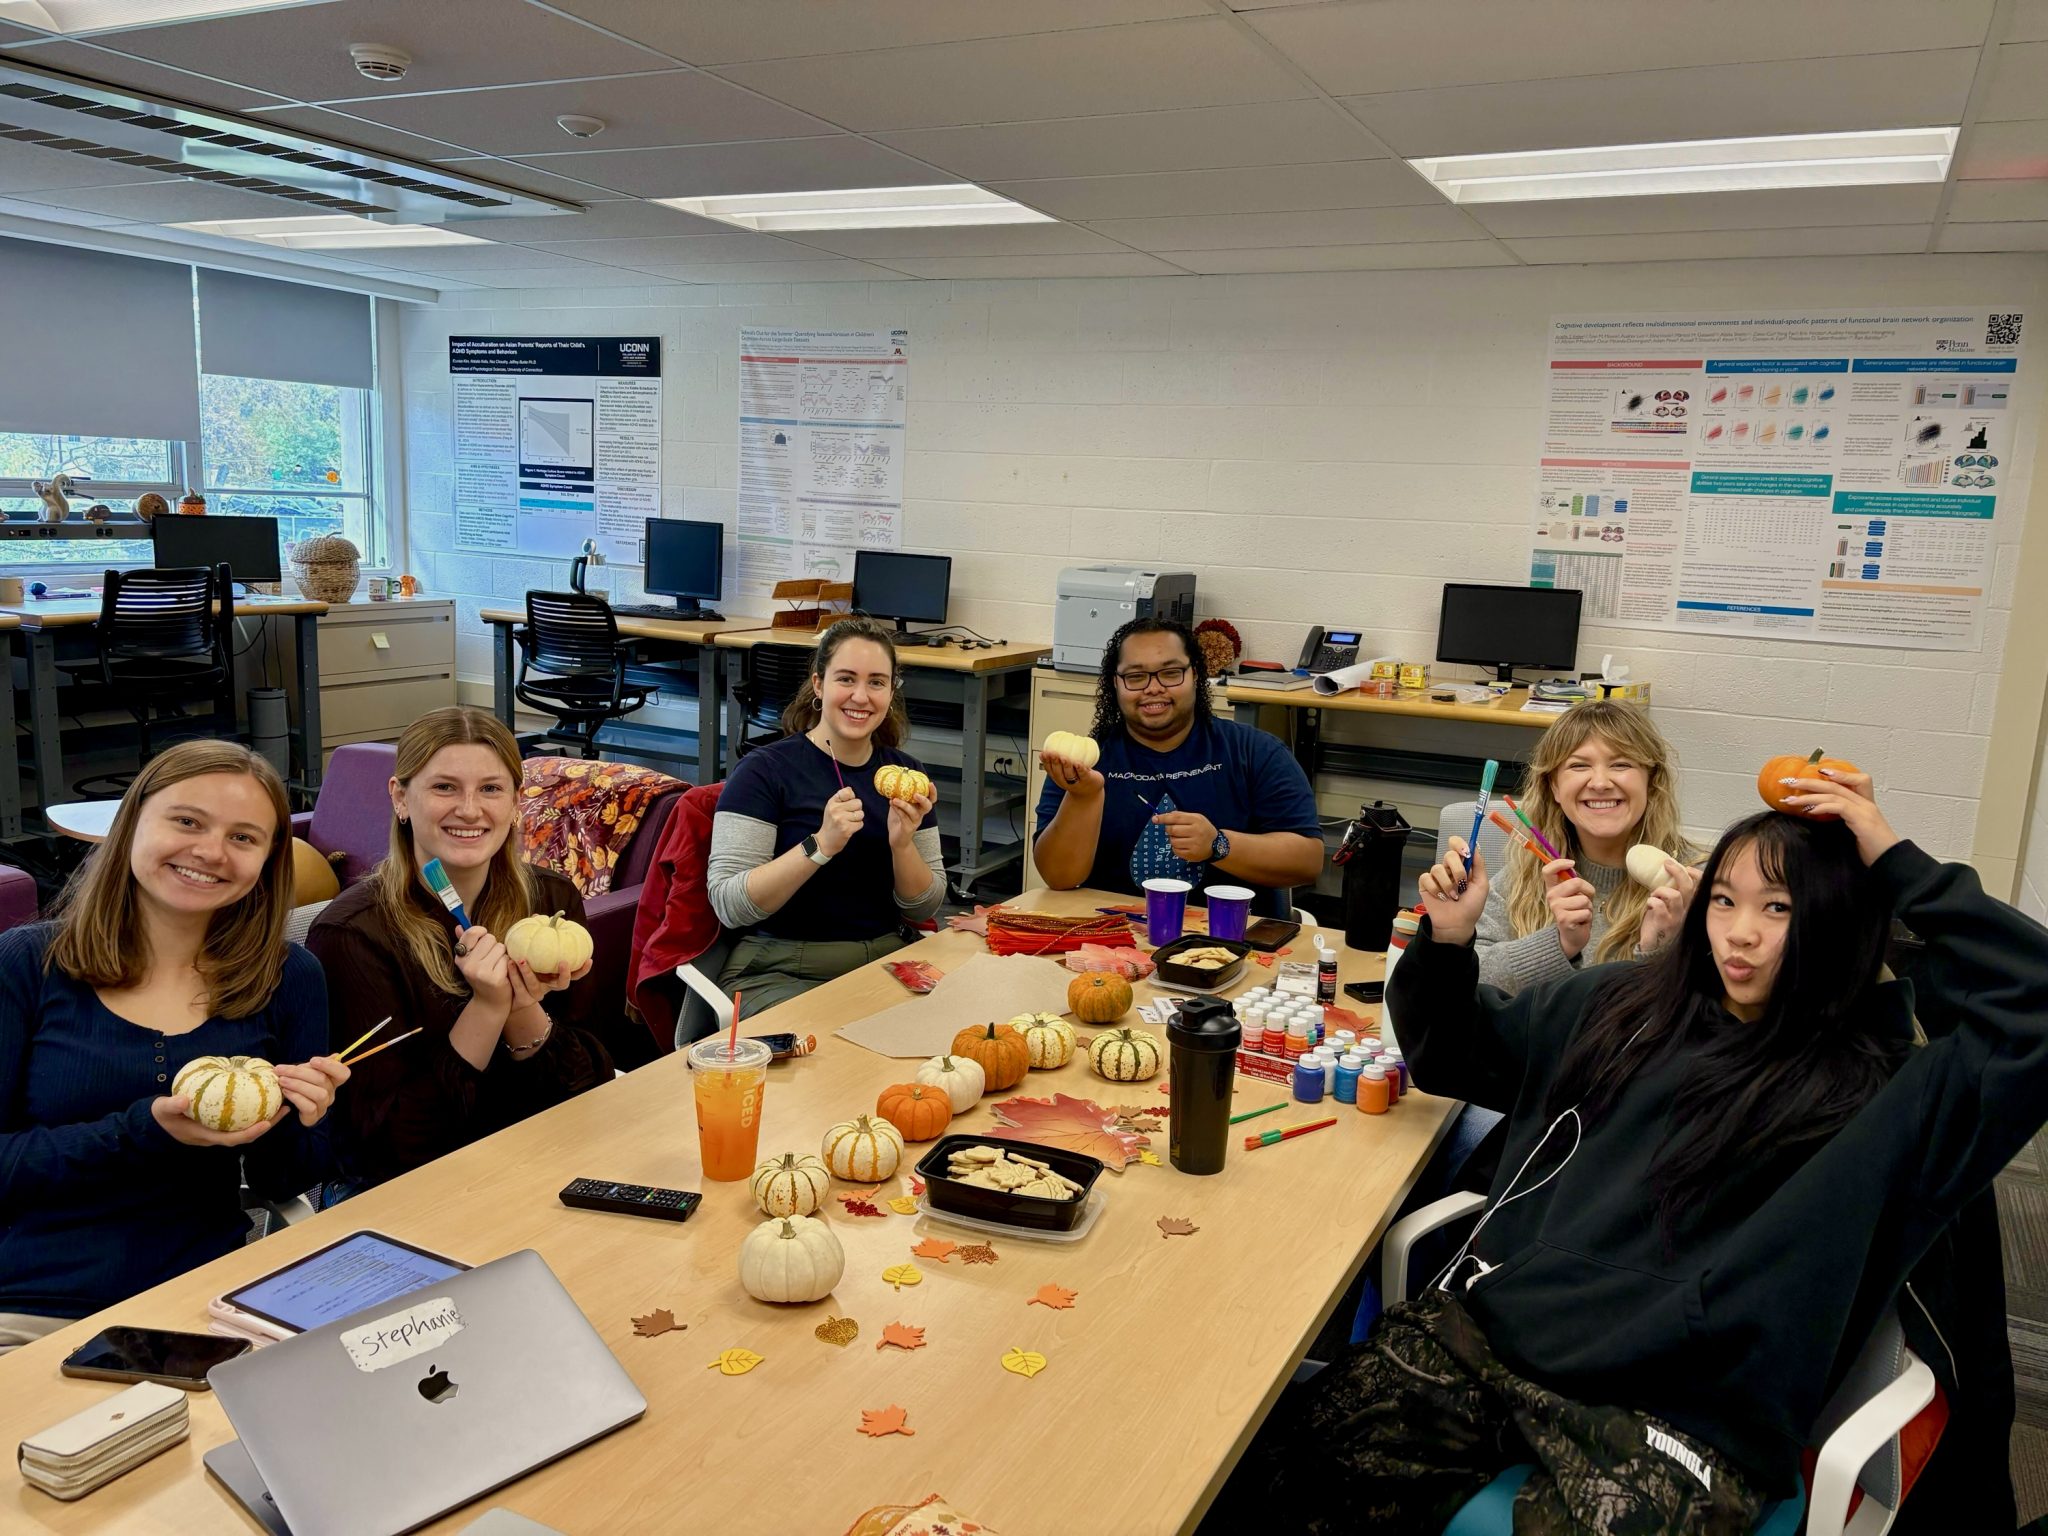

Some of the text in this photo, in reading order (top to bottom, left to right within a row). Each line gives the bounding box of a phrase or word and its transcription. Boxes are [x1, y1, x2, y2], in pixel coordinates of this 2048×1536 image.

[620, 343, 650, 352] UCONN
[1108, 764, 1222, 781] MACRODATA REFINEMENT
[741, 1088, 755, 1128] ICED
[362, 1308, 460, 1356] Stephanie
